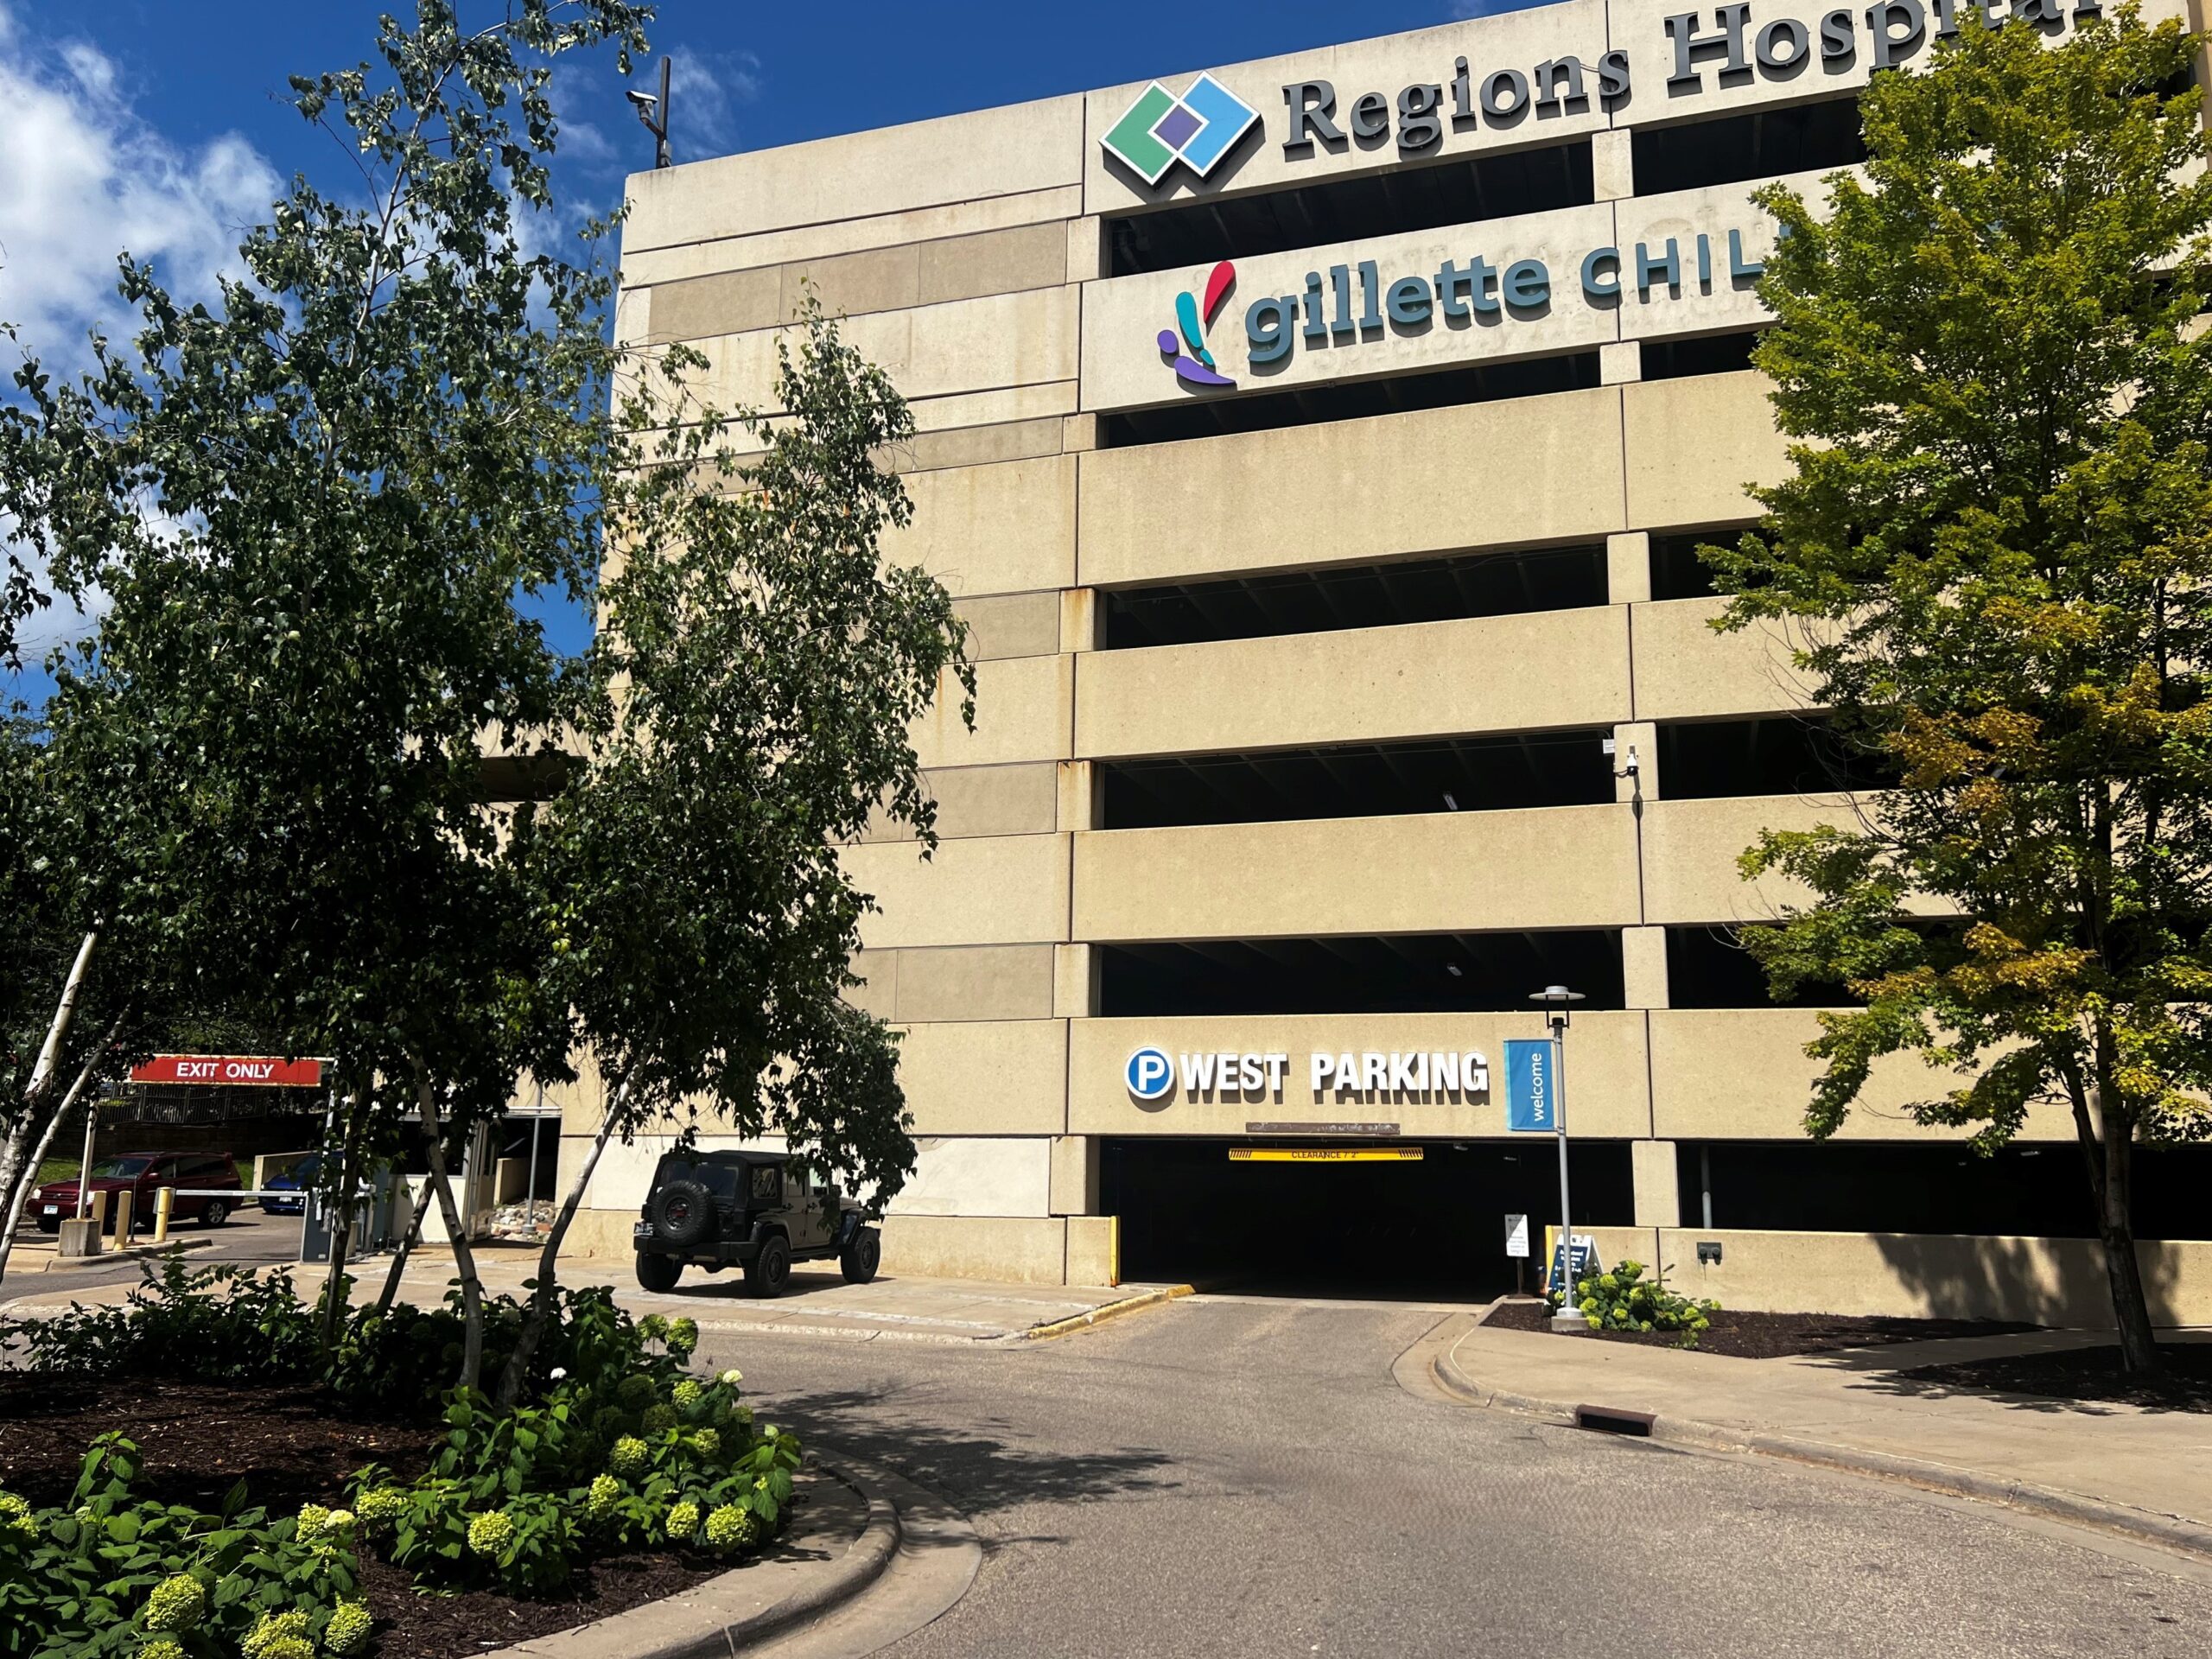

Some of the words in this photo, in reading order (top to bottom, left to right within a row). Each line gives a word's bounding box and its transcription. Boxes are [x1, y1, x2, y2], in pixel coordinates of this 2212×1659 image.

[1282, 49, 1630, 151] Regions
[1664, 0, 2102, 84] Hosp
[1245, 254, 1551, 363] gillette
[1580, 223, 1793, 297] CHIL
[176, 1062, 219, 1077] EXIT
[226, 1063, 274, 1079] ONLY
[1138, 1055, 1166, 1091] P
[1179, 1052, 1288, 1092] WEST
[1311, 1051, 1489, 1092] PARKING
[1529, 1052, 1545, 1122] welcome
